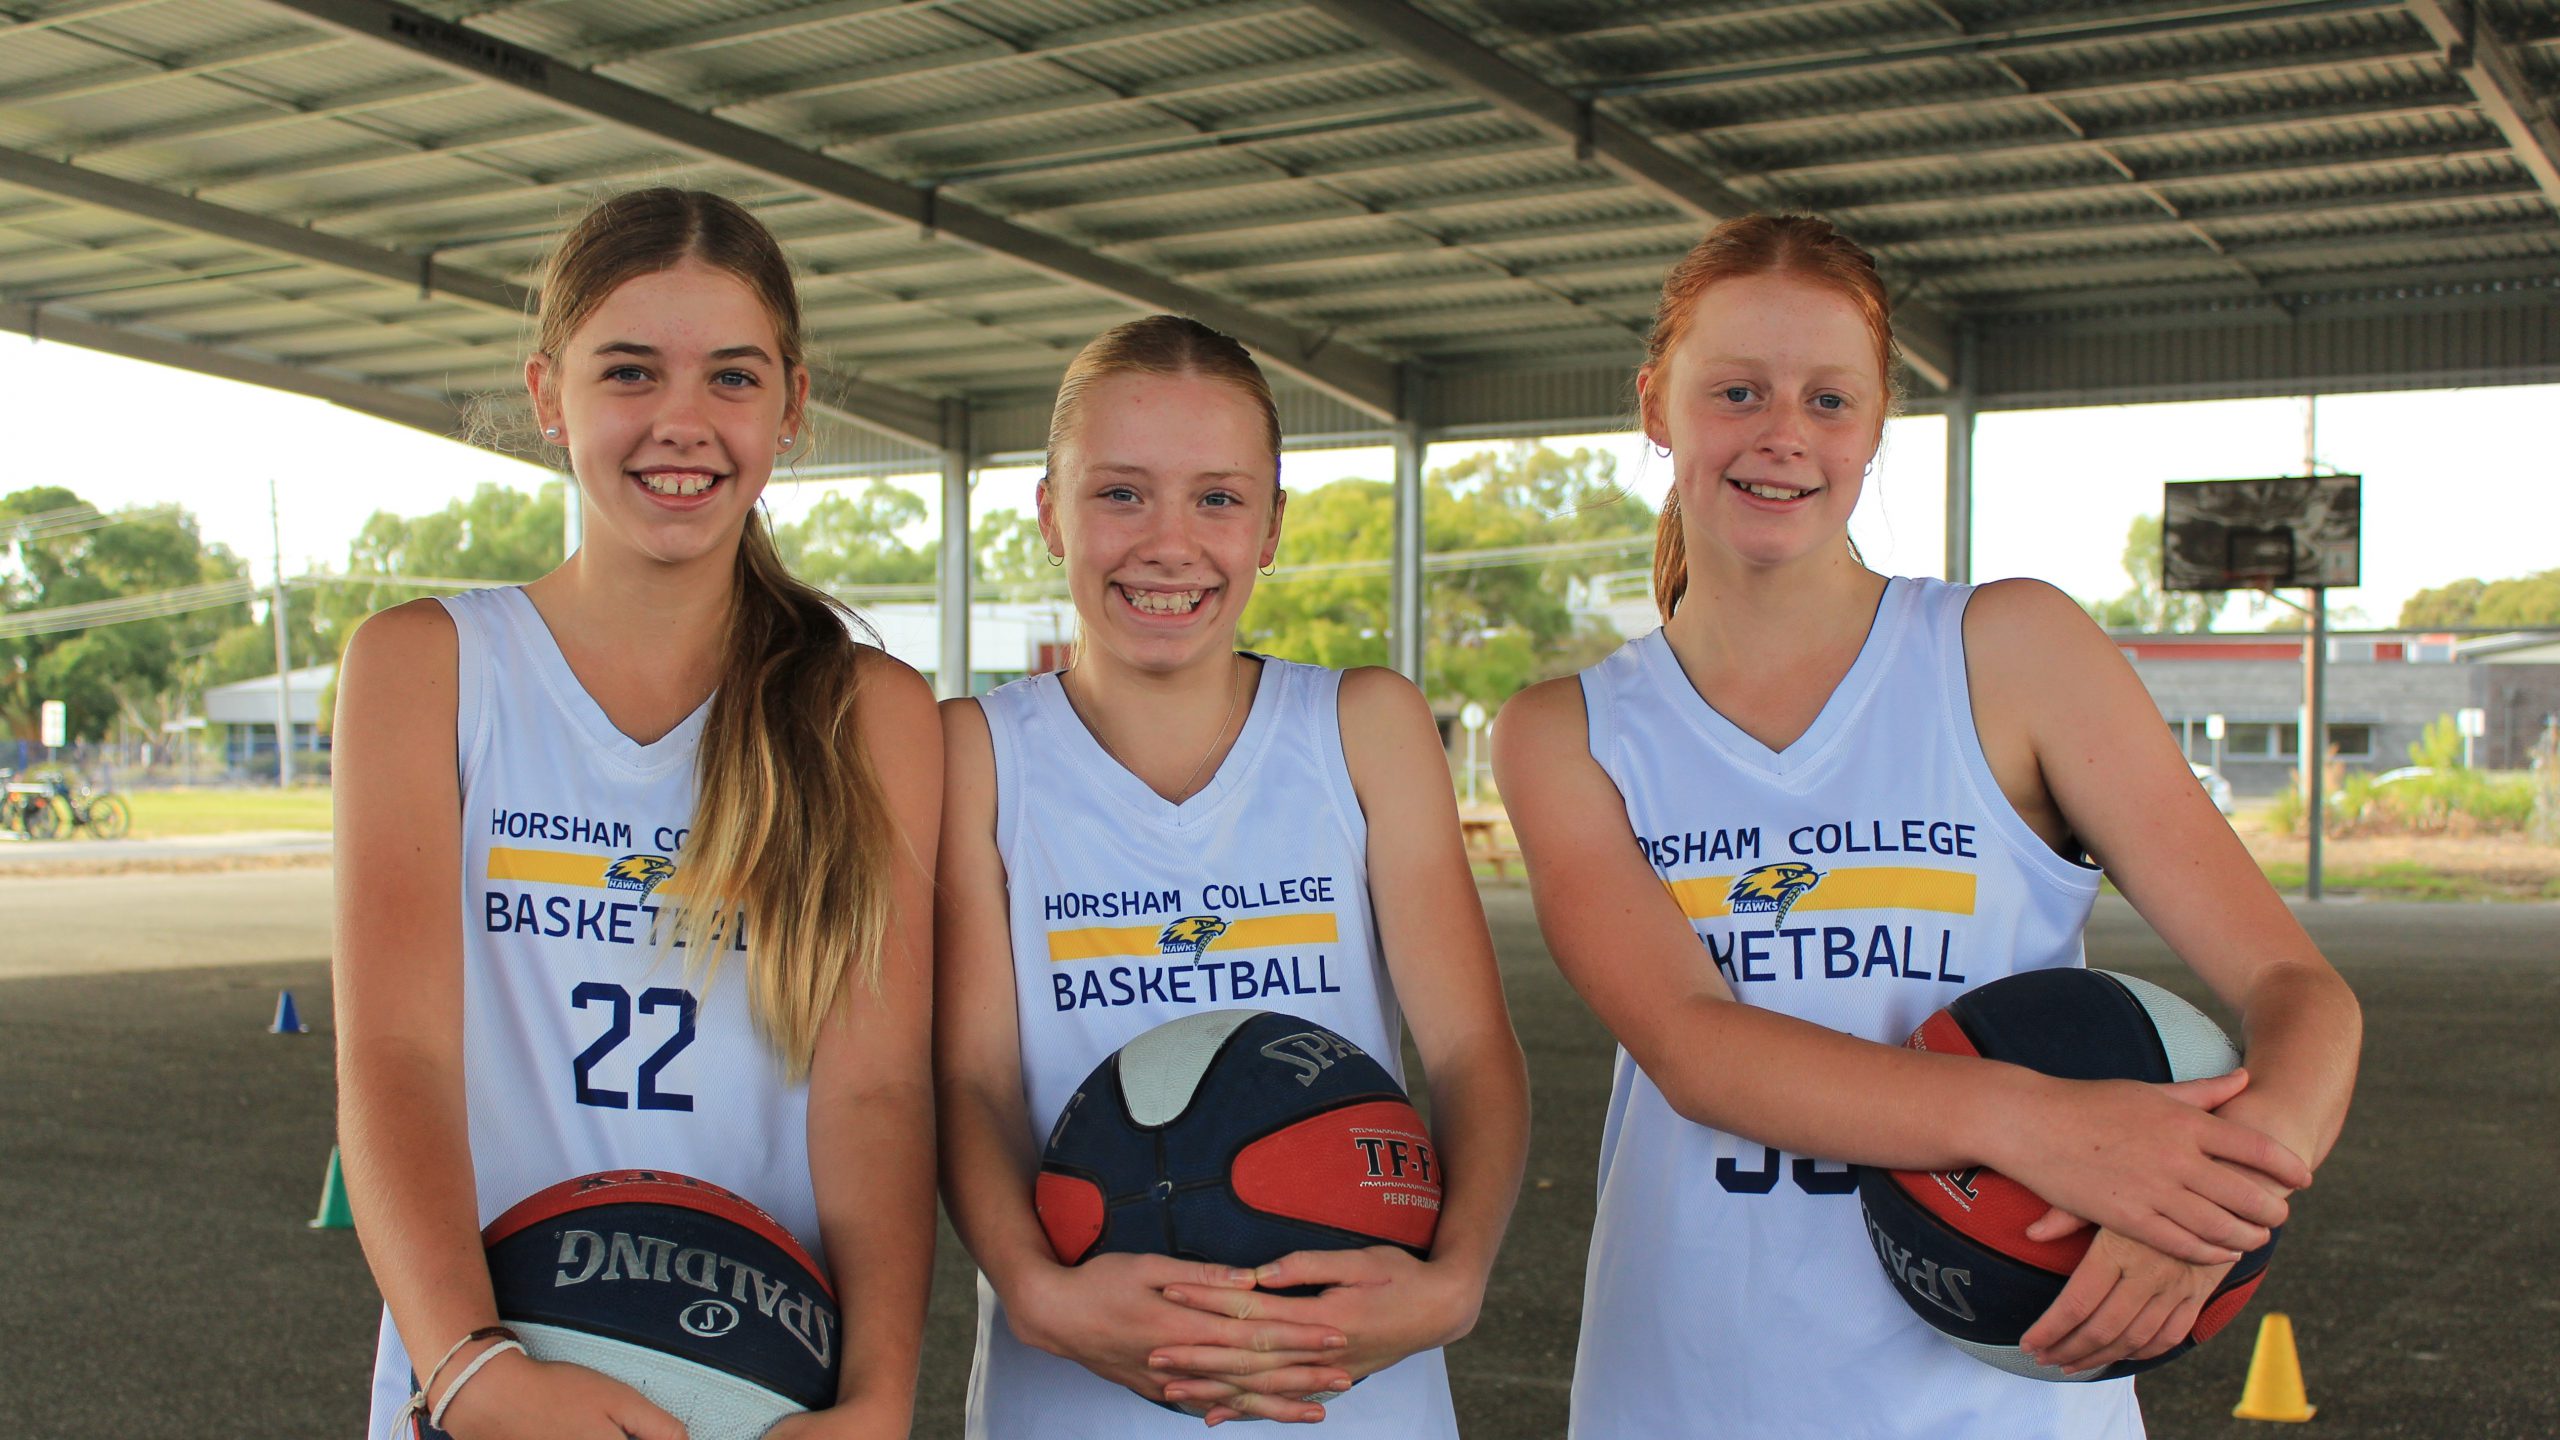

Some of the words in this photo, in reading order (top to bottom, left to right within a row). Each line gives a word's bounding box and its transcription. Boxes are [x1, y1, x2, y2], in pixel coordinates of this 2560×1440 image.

[491, 808, 633, 849] HORSHAM
[1788, 820, 1977, 858] COLLEGE
[609, 879, 645, 891] HAWKS
[1045, 889, 1182, 920] HORSHAM
[1202, 876, 1335, 911] COLLEGE
[1735, 901, 1779, 912] HAWKS
[1163, 943, 1198, 953] HAWKS
[1699, 924, 1966, 984] KETBALL
[1052, 954, 1341, 1012] BASKETBALL
[571, 981, 698, 1113] 22
[1260, 1030, 1366, 1088] SPA
[554, 1230, 834, 1369] SPALDING
